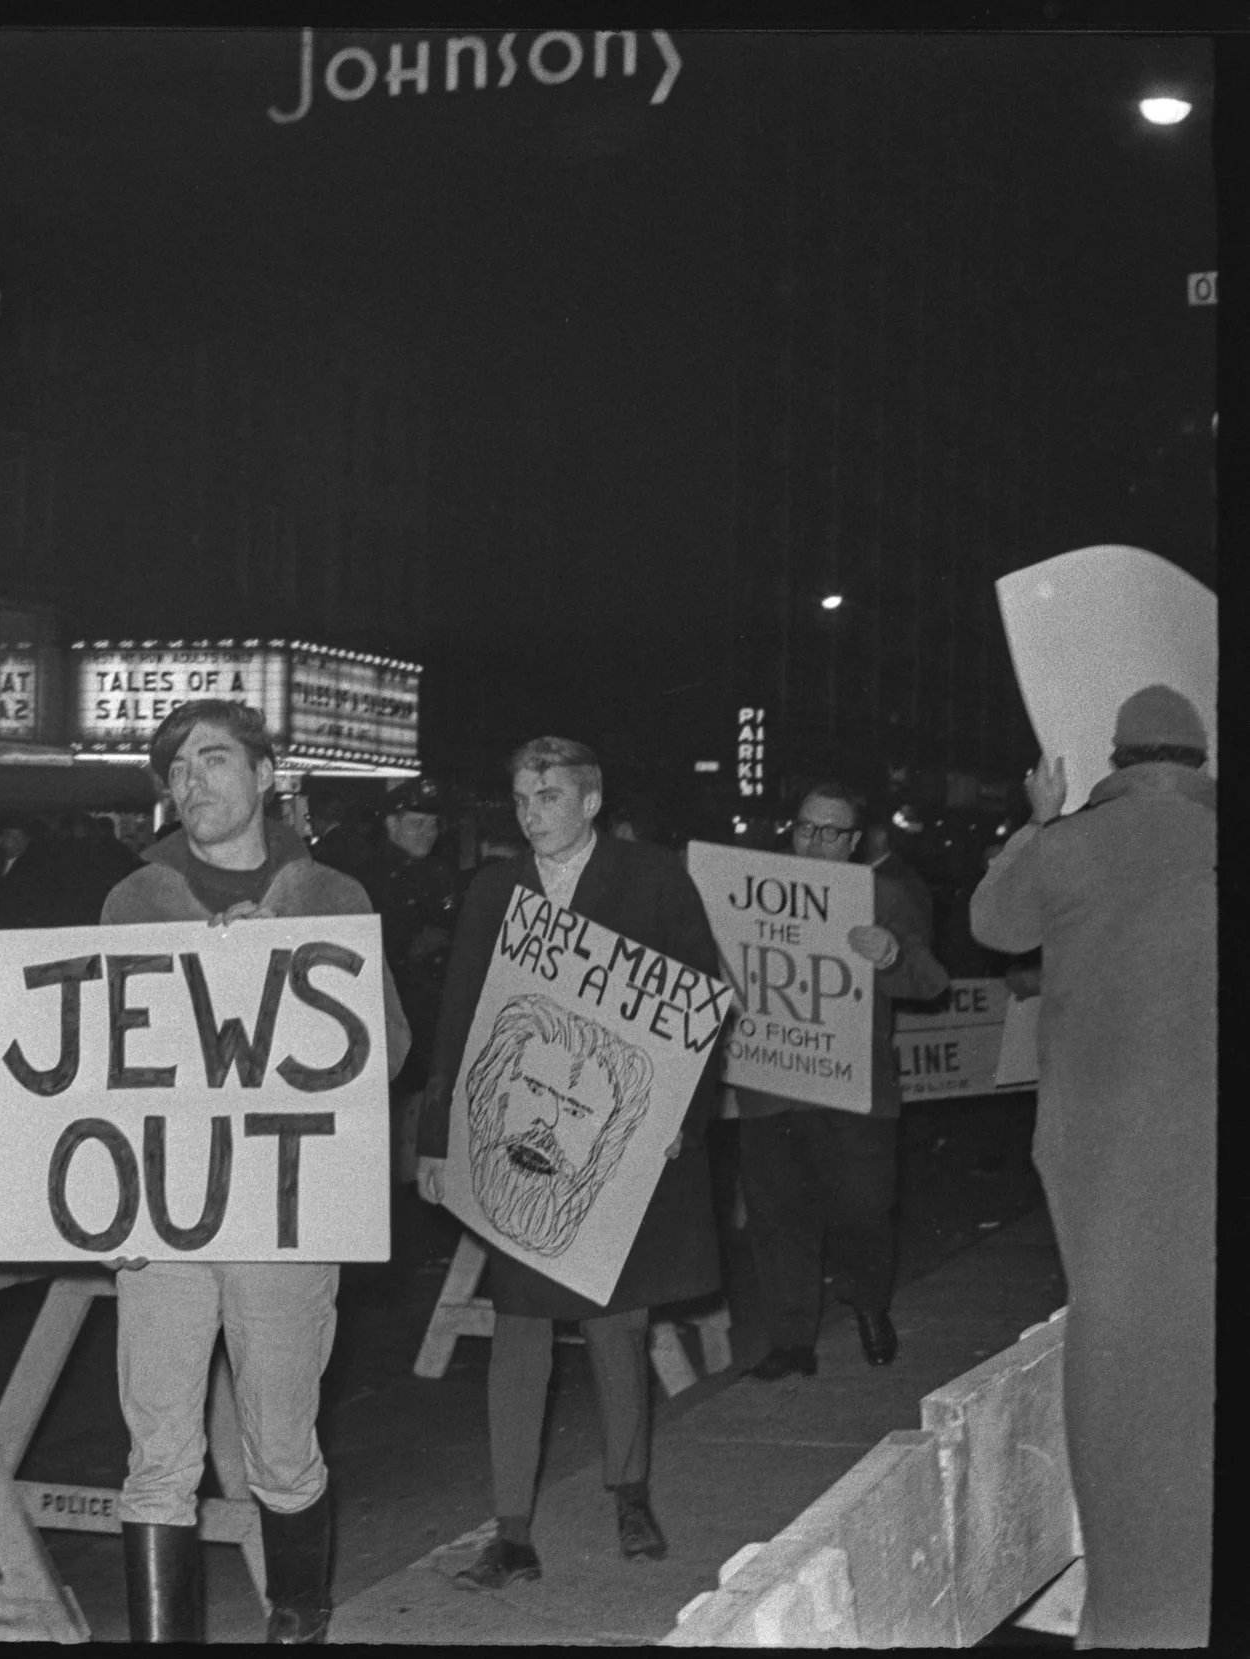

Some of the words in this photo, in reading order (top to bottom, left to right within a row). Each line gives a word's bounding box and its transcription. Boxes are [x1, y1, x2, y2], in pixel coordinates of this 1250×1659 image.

[96, 671, 175, 692] TALES
[188, 671, 220, 692] OF
[230, 671, 245, 692] A
[728, 875, 831, 923] JOIN
[510, 885, 592, 961] KARL
[607, 934, 734, 1023] MARX
[754, 919, 801, 946] THE
[499, 918, 566, 982] WAS
[577, 964, 610, 1007] A
[619, 982, 722, 1054] JEW
[2, 940, 371, 1097] JEWS
[765, 1022, 837, 1052] FIGHT
[727, 1039, 854, 1082] OMMUNISM
[896, 1041, 961, 1077] LINE
[47, 1111, 337, 1253] OUT
[40, 1491, 115, 1519] POLICE
